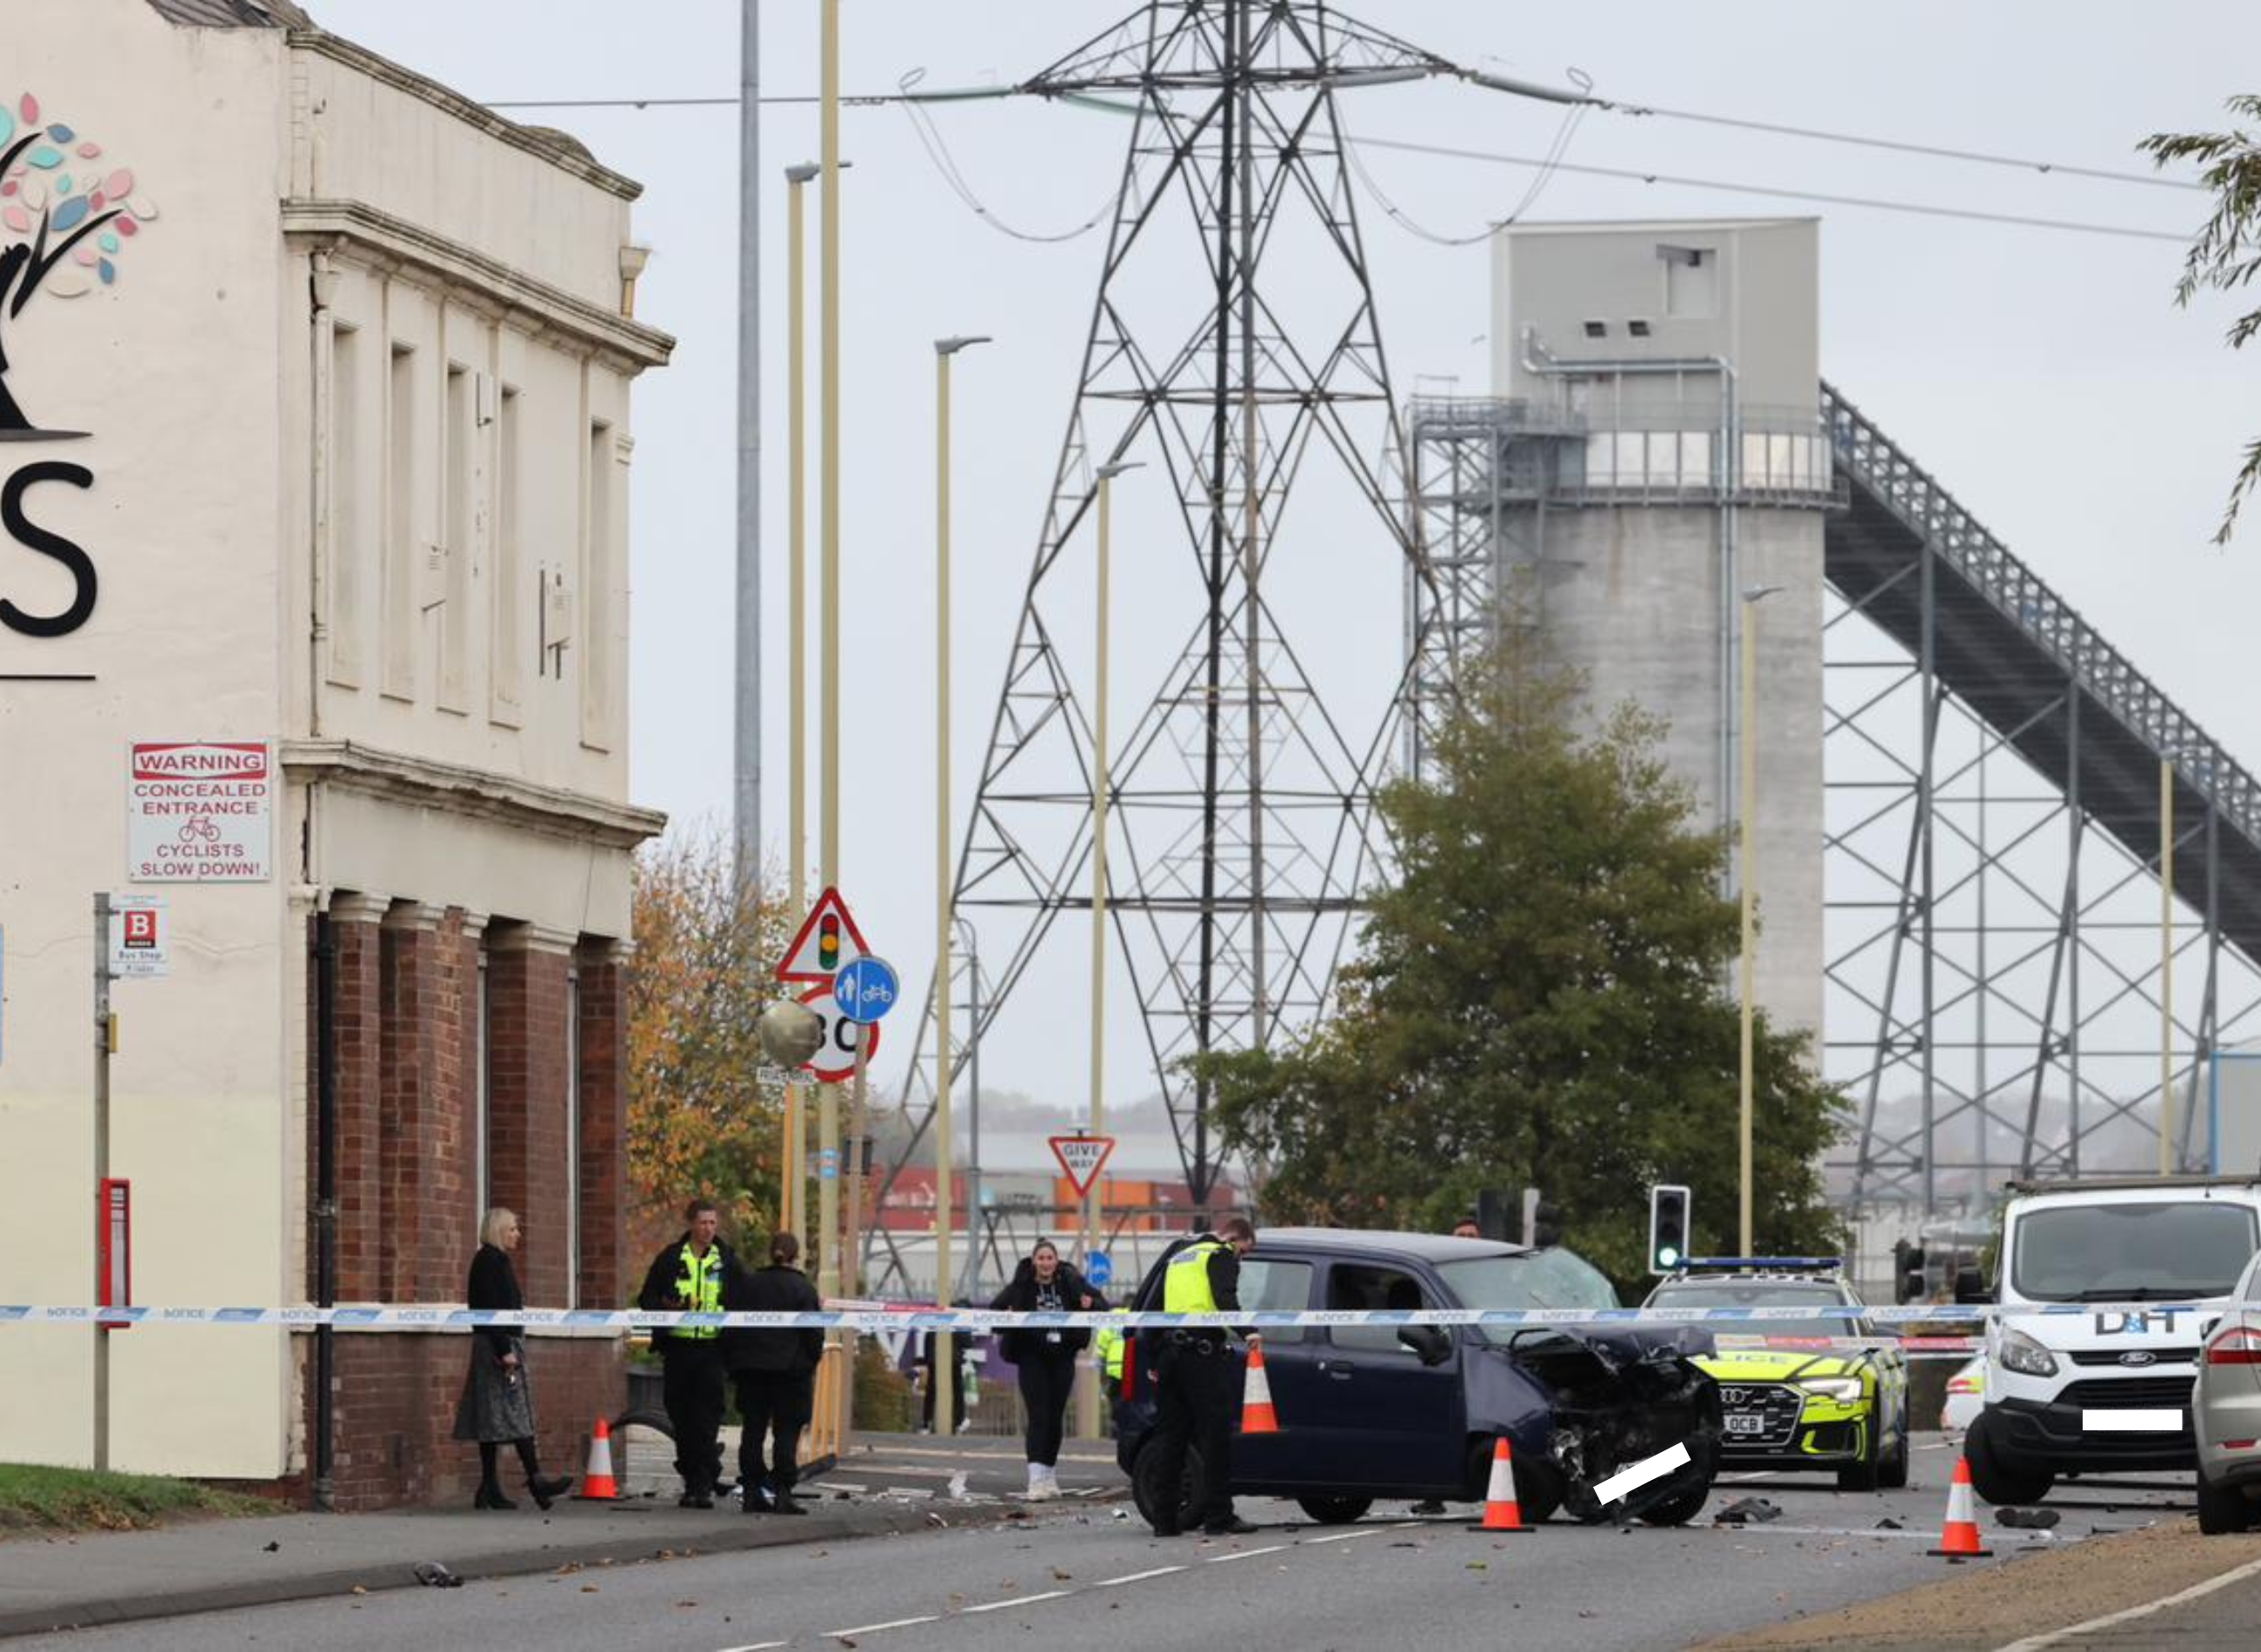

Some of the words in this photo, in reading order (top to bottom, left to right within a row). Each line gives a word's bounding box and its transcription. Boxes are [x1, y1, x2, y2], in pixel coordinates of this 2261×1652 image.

[0, 461, 97, 637] S
[139, 755, 262, 770] WARNING
[135, 783, 265, 796] CONCEALED
[143, 802, 258, 815] ENTRANCE
[157, 843, 244, 858] CYCLISTS
[141, 863, 194, 876] SLOW
[199, 863, 260, 876] DOWN!
[130, 914, 150, 936] B
[1063, 1143, 1099, 1156] GIVE
[1069, 1159, 1095, 1169] WAY
[1730, 1417, 1758, 1431] OCB
